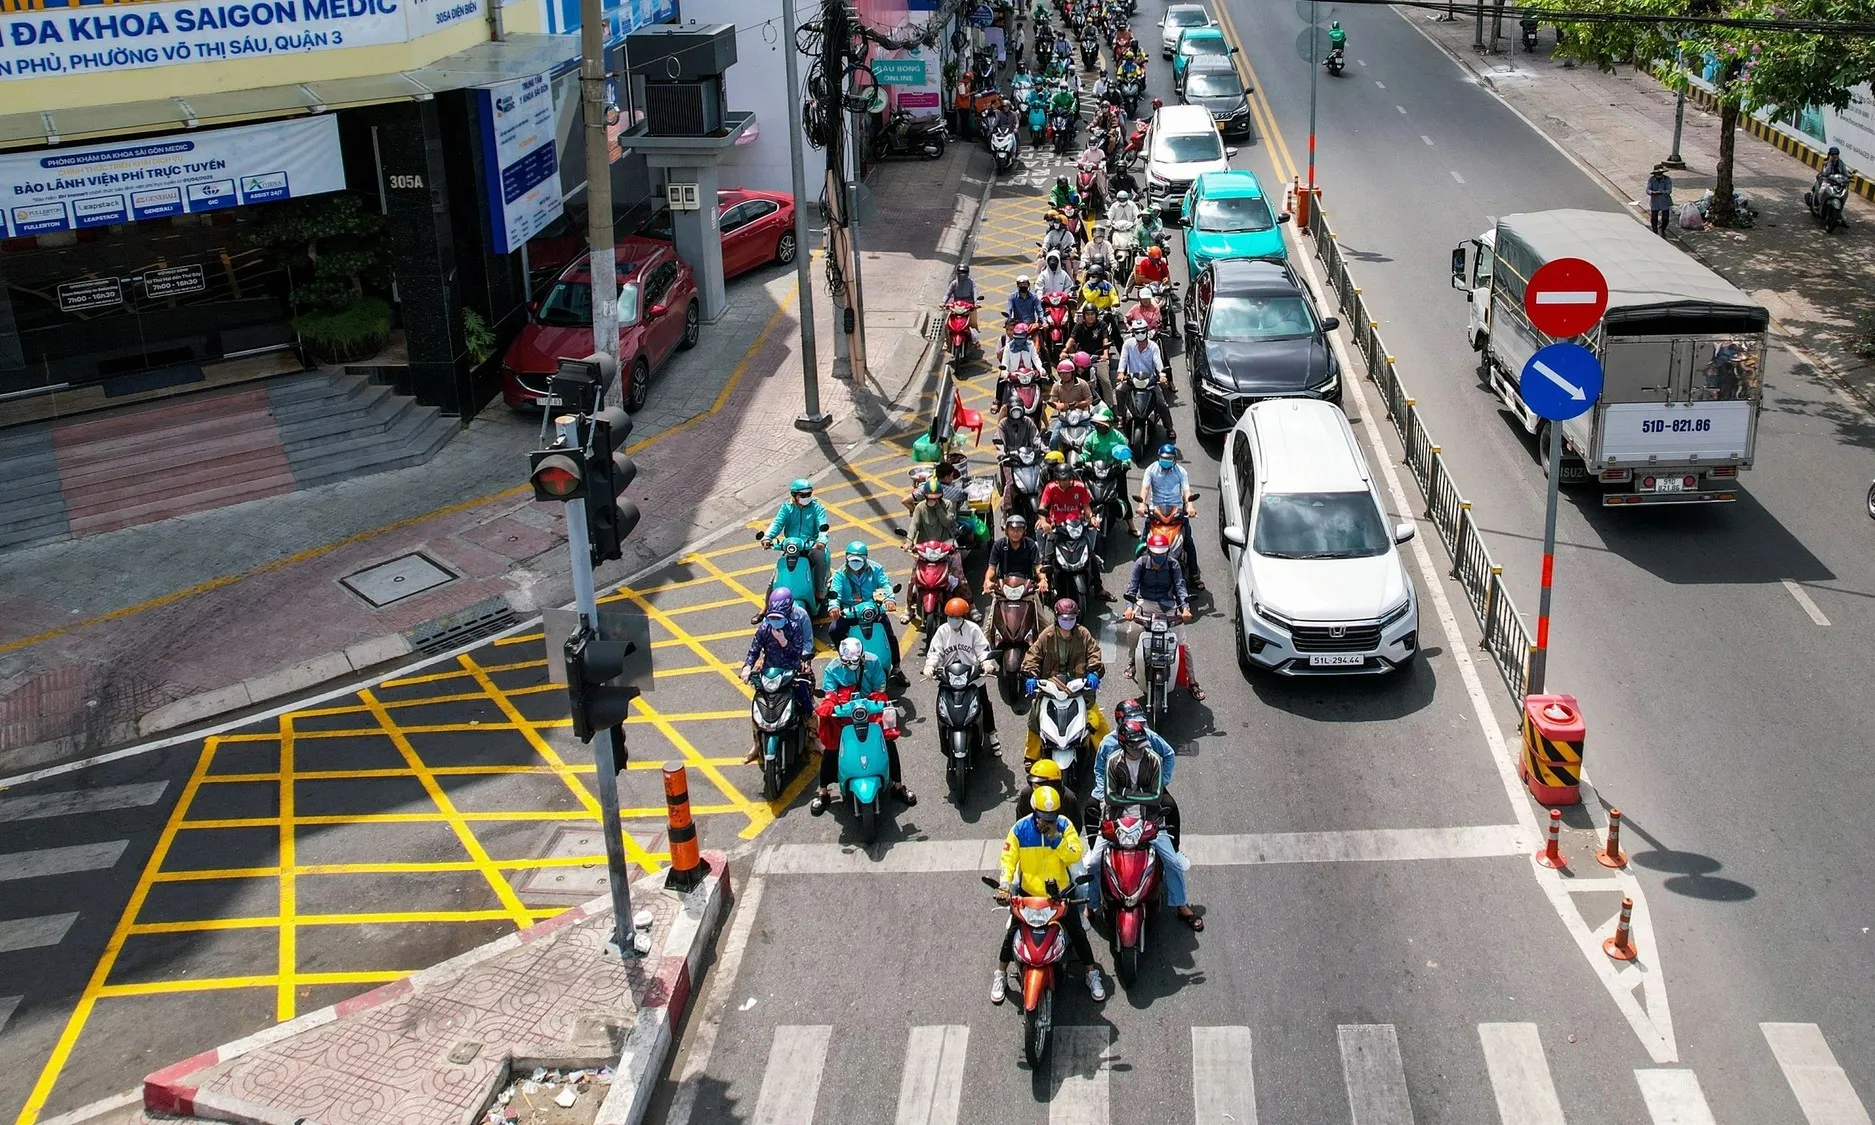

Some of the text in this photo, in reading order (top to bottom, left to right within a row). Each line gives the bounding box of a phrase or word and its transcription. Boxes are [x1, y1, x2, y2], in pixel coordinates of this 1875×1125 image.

[11, 20, 63, 46] ĐA
[69, 12, 169, 42] KHOA
[174, 0, 297, 32] SAIGON
[303, 0, 397, 21] MEDIC
[436, 11, 451, 24] 305A
[16, 53, 67, 73] PHỦ,
[70, 47, 158, 69] PHƯỜNG
[162, 42, 191, 60] VÕ
[194, 41, 226, 59] THỊ
[230, 35, 272, 54] SÁU,
[275, 30, 328, 51] QUẬN
[332, 31, 343, 45] 3
[165, 143, 188, 153] MEDIC
[47, 178, 86, 192] LÃNH
[87, 172, 120, 187] VIỆN
[121, 169, 144, 182] PHÍ
[146, 165, 181, 179] TRỰC
[182, 157, 226, 173] TUYẾN
[390, 175, 424, 189] 305A
[78, 200, 120, 211] Leapstack
[144, 206, 173, 215] GENERALI
[83, 213, 119, 223] LEAPSTACK
[23, 221, 60, 231] FULLERTON
[152, 282, 171, 291] 7h00
[176, 278, 198, 287] 16h30
[68, 295, 87, 303] 7h00
[92, 291, 116, 300] 16h30
[1642, 418, 1711, 433] 51D-821.86
[1314, 656, 1360, 665] 51L-294.44
